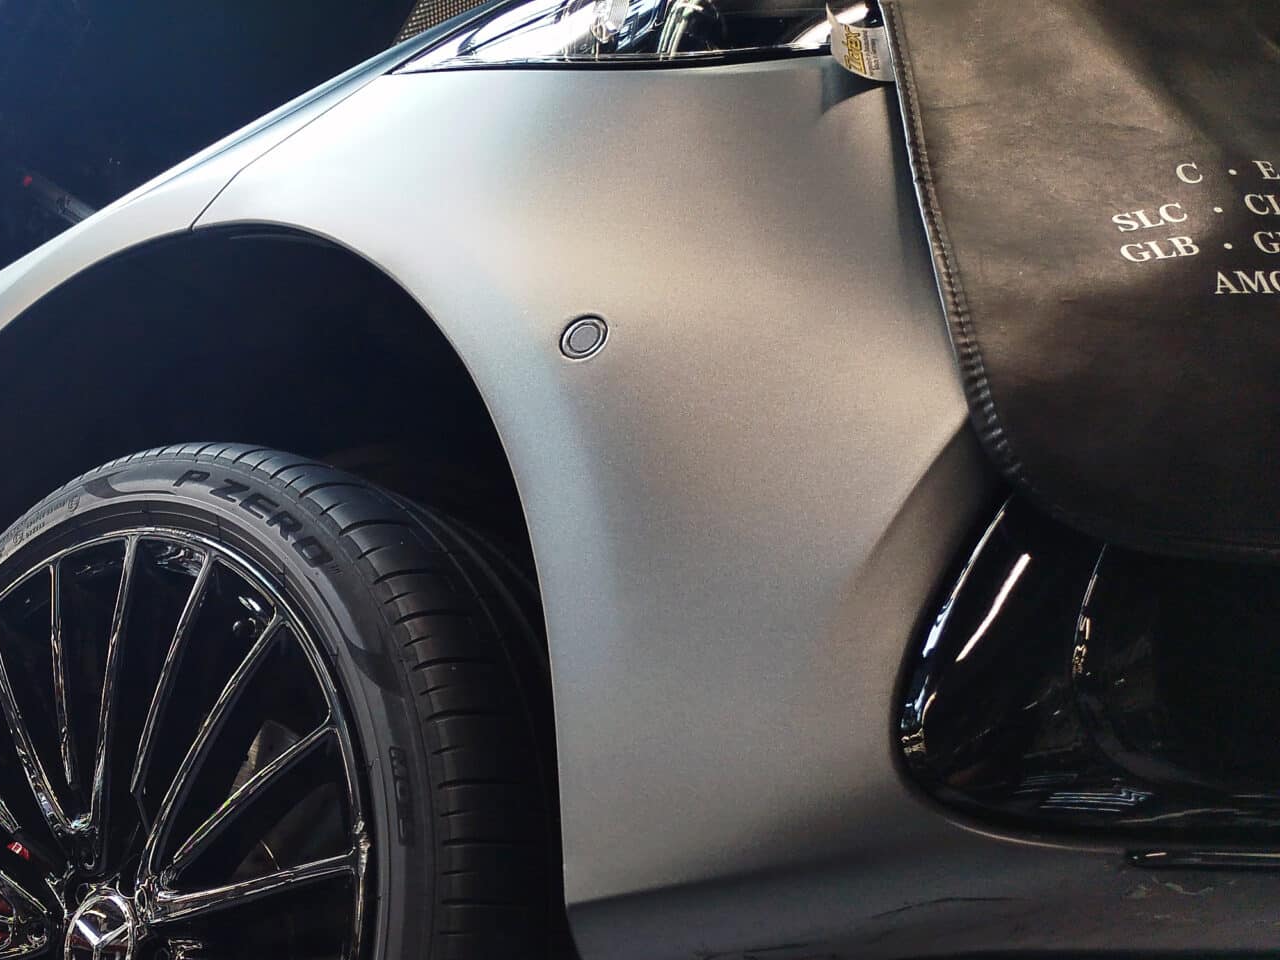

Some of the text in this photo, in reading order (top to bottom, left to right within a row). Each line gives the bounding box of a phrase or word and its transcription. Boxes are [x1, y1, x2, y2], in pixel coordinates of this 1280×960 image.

[1176, 162, 1203, 183] C
[1111, 202, 1188, 232] SLC
[1120, 236, 1200, 262] GLB
[209, 478, 334, 568] ZERO
